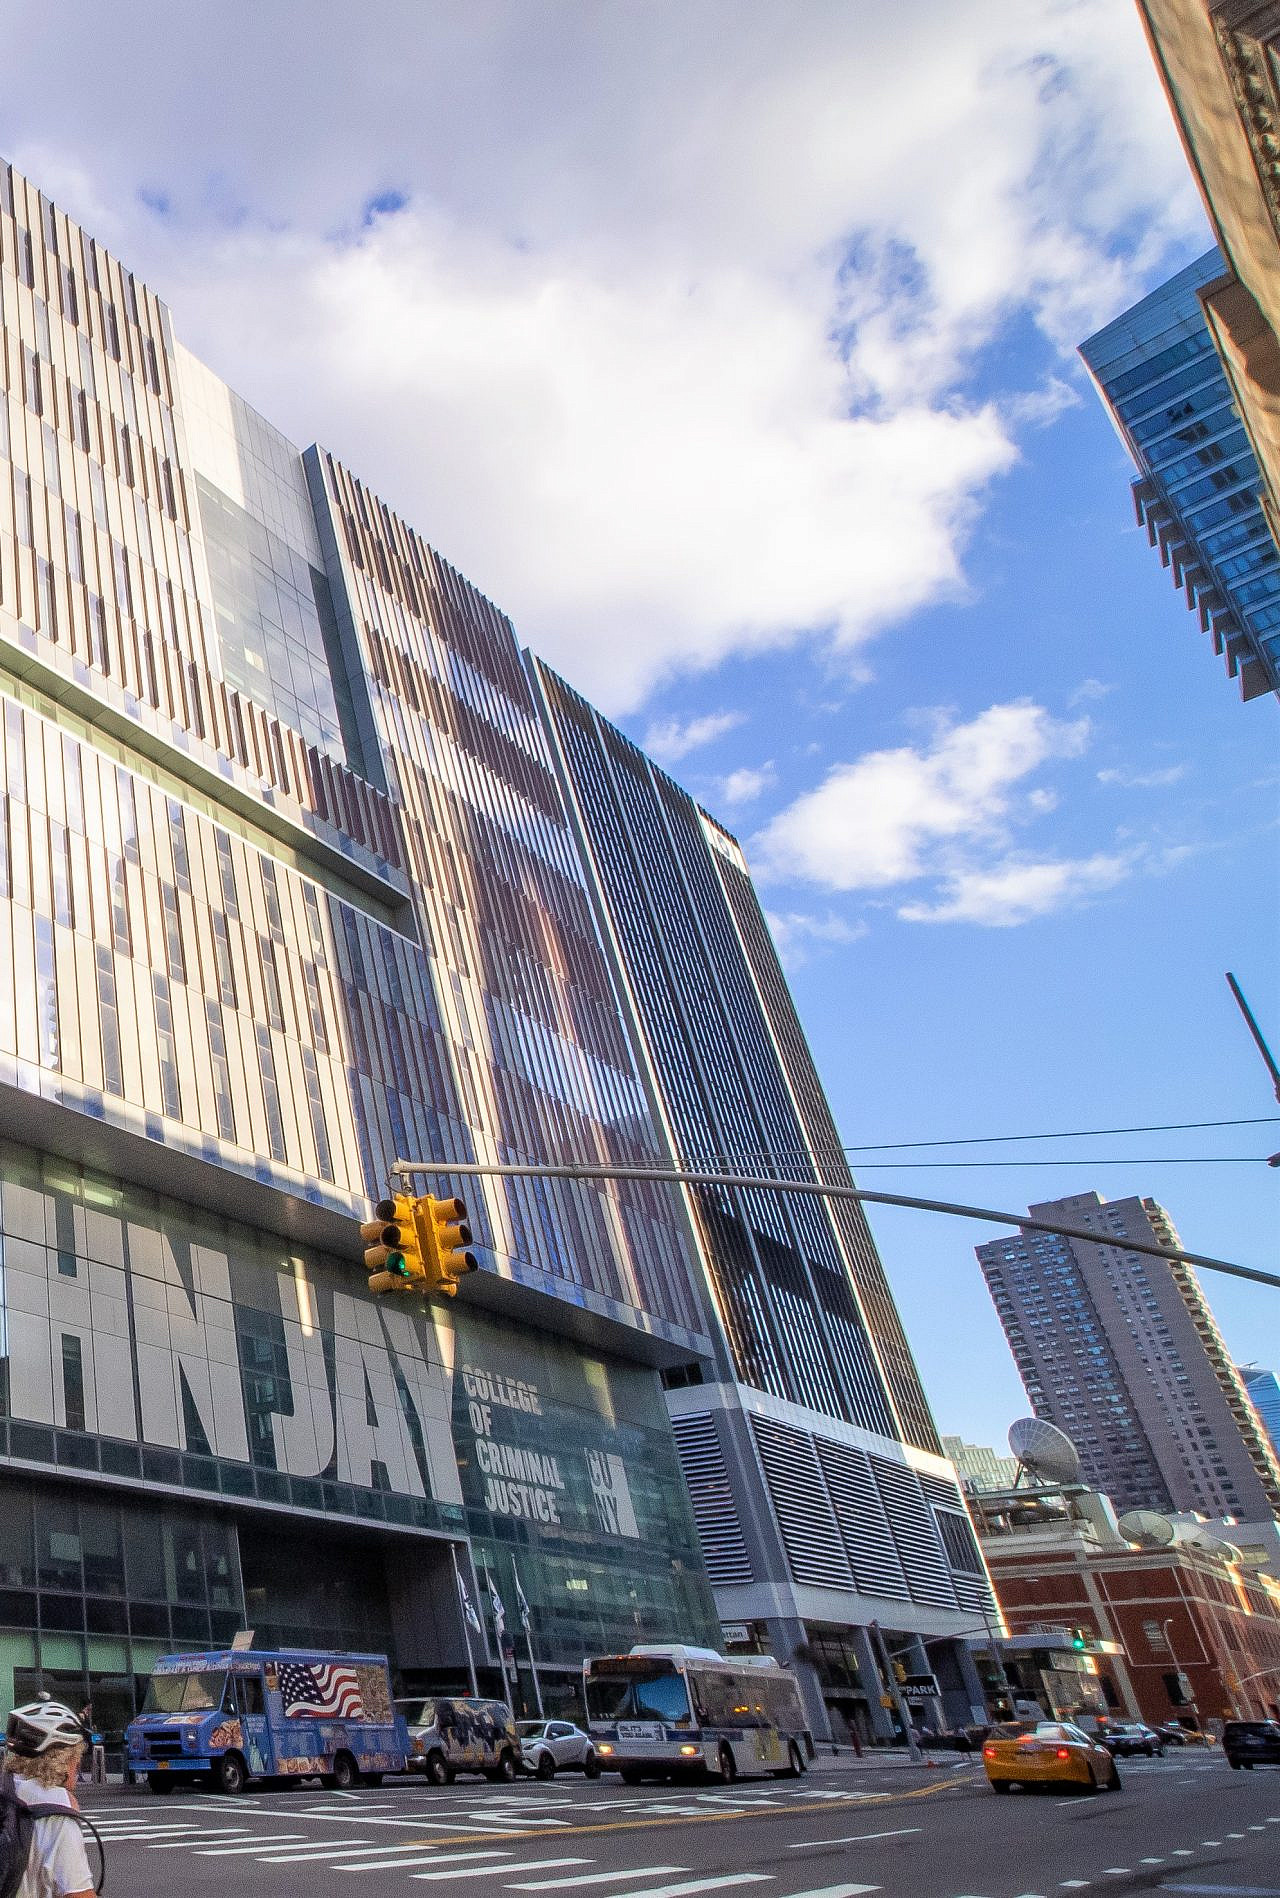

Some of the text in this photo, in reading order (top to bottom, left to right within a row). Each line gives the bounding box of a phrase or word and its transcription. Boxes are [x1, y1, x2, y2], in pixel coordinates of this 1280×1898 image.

[270, 1272, 464, 1506] JAY
[462, 1364, 542, 1416] COLLEGE
[469, 1401, 492, 1437] OF
[475, 1438, 566, 1490] CRIMINAL
[484, 1477, 561, 1525] JUSTICE
[905, 1685, 936, 1695] PARK
